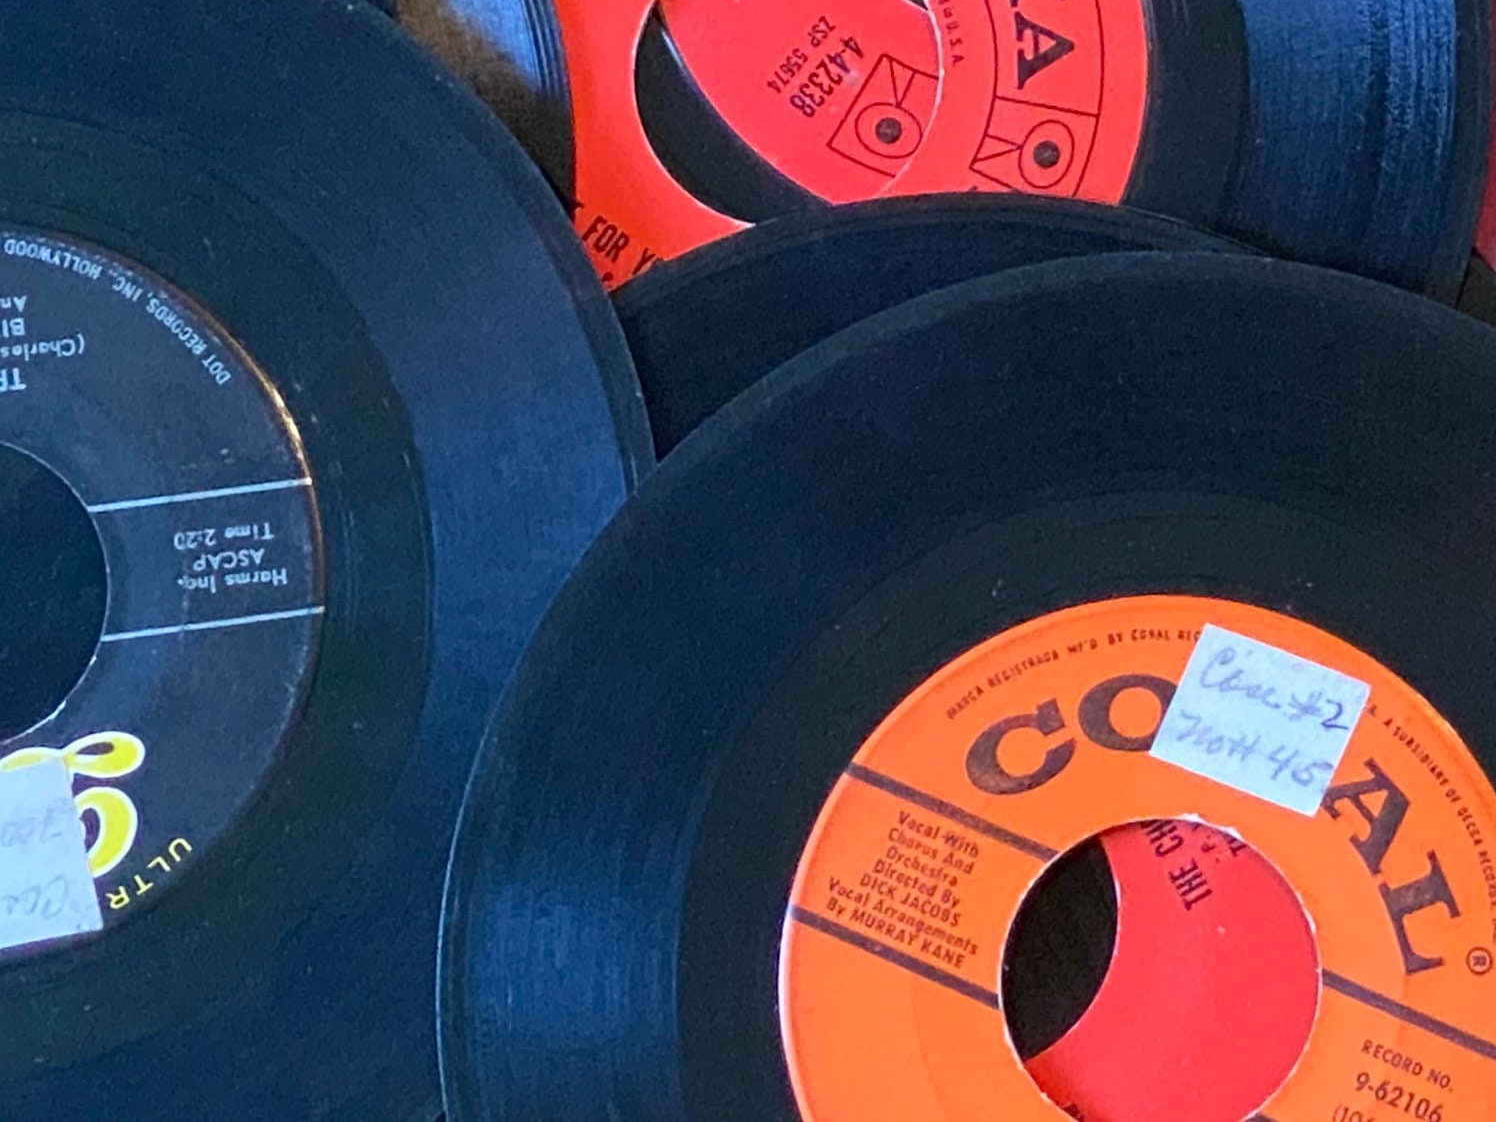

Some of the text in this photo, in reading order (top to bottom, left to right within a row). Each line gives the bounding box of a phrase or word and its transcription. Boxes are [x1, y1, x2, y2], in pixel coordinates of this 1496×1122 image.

[808, 15, 837, 49] ZSP
[789, 34, 866, 119] 4-42338
[3, 237, 104, 281] HOLLYWOOD
[581, 215, 633, 265] FOR
[201, 357, 233, 387] DOT
[172, 521, 276, 550] Time 2:20
[192, 547, 267, 573] ASCAP
[225, 565, 289, 587] Harms
[898, 810, 941, 841] Vocal
[965, 673, 1461, 976] COAL
[105, 837, 194, 910] ULTR
[885, 845, 959, 888] Orchestra
[887, 827, 976, 876] Chorus And
[859, 872, 962, 928] DICK JACOBS
[873, 858, 961, 909] Directed By
[1167, 862, 1214, 912] THE
[826, 897, 967, 970] By MURRAY KANE
[828, 876, 980, 957] Vocal Arrangements
[1360, 1038, 1454, 1093] RECORD NO.
[1354, 1071, 1444, 1122] 9-62106
